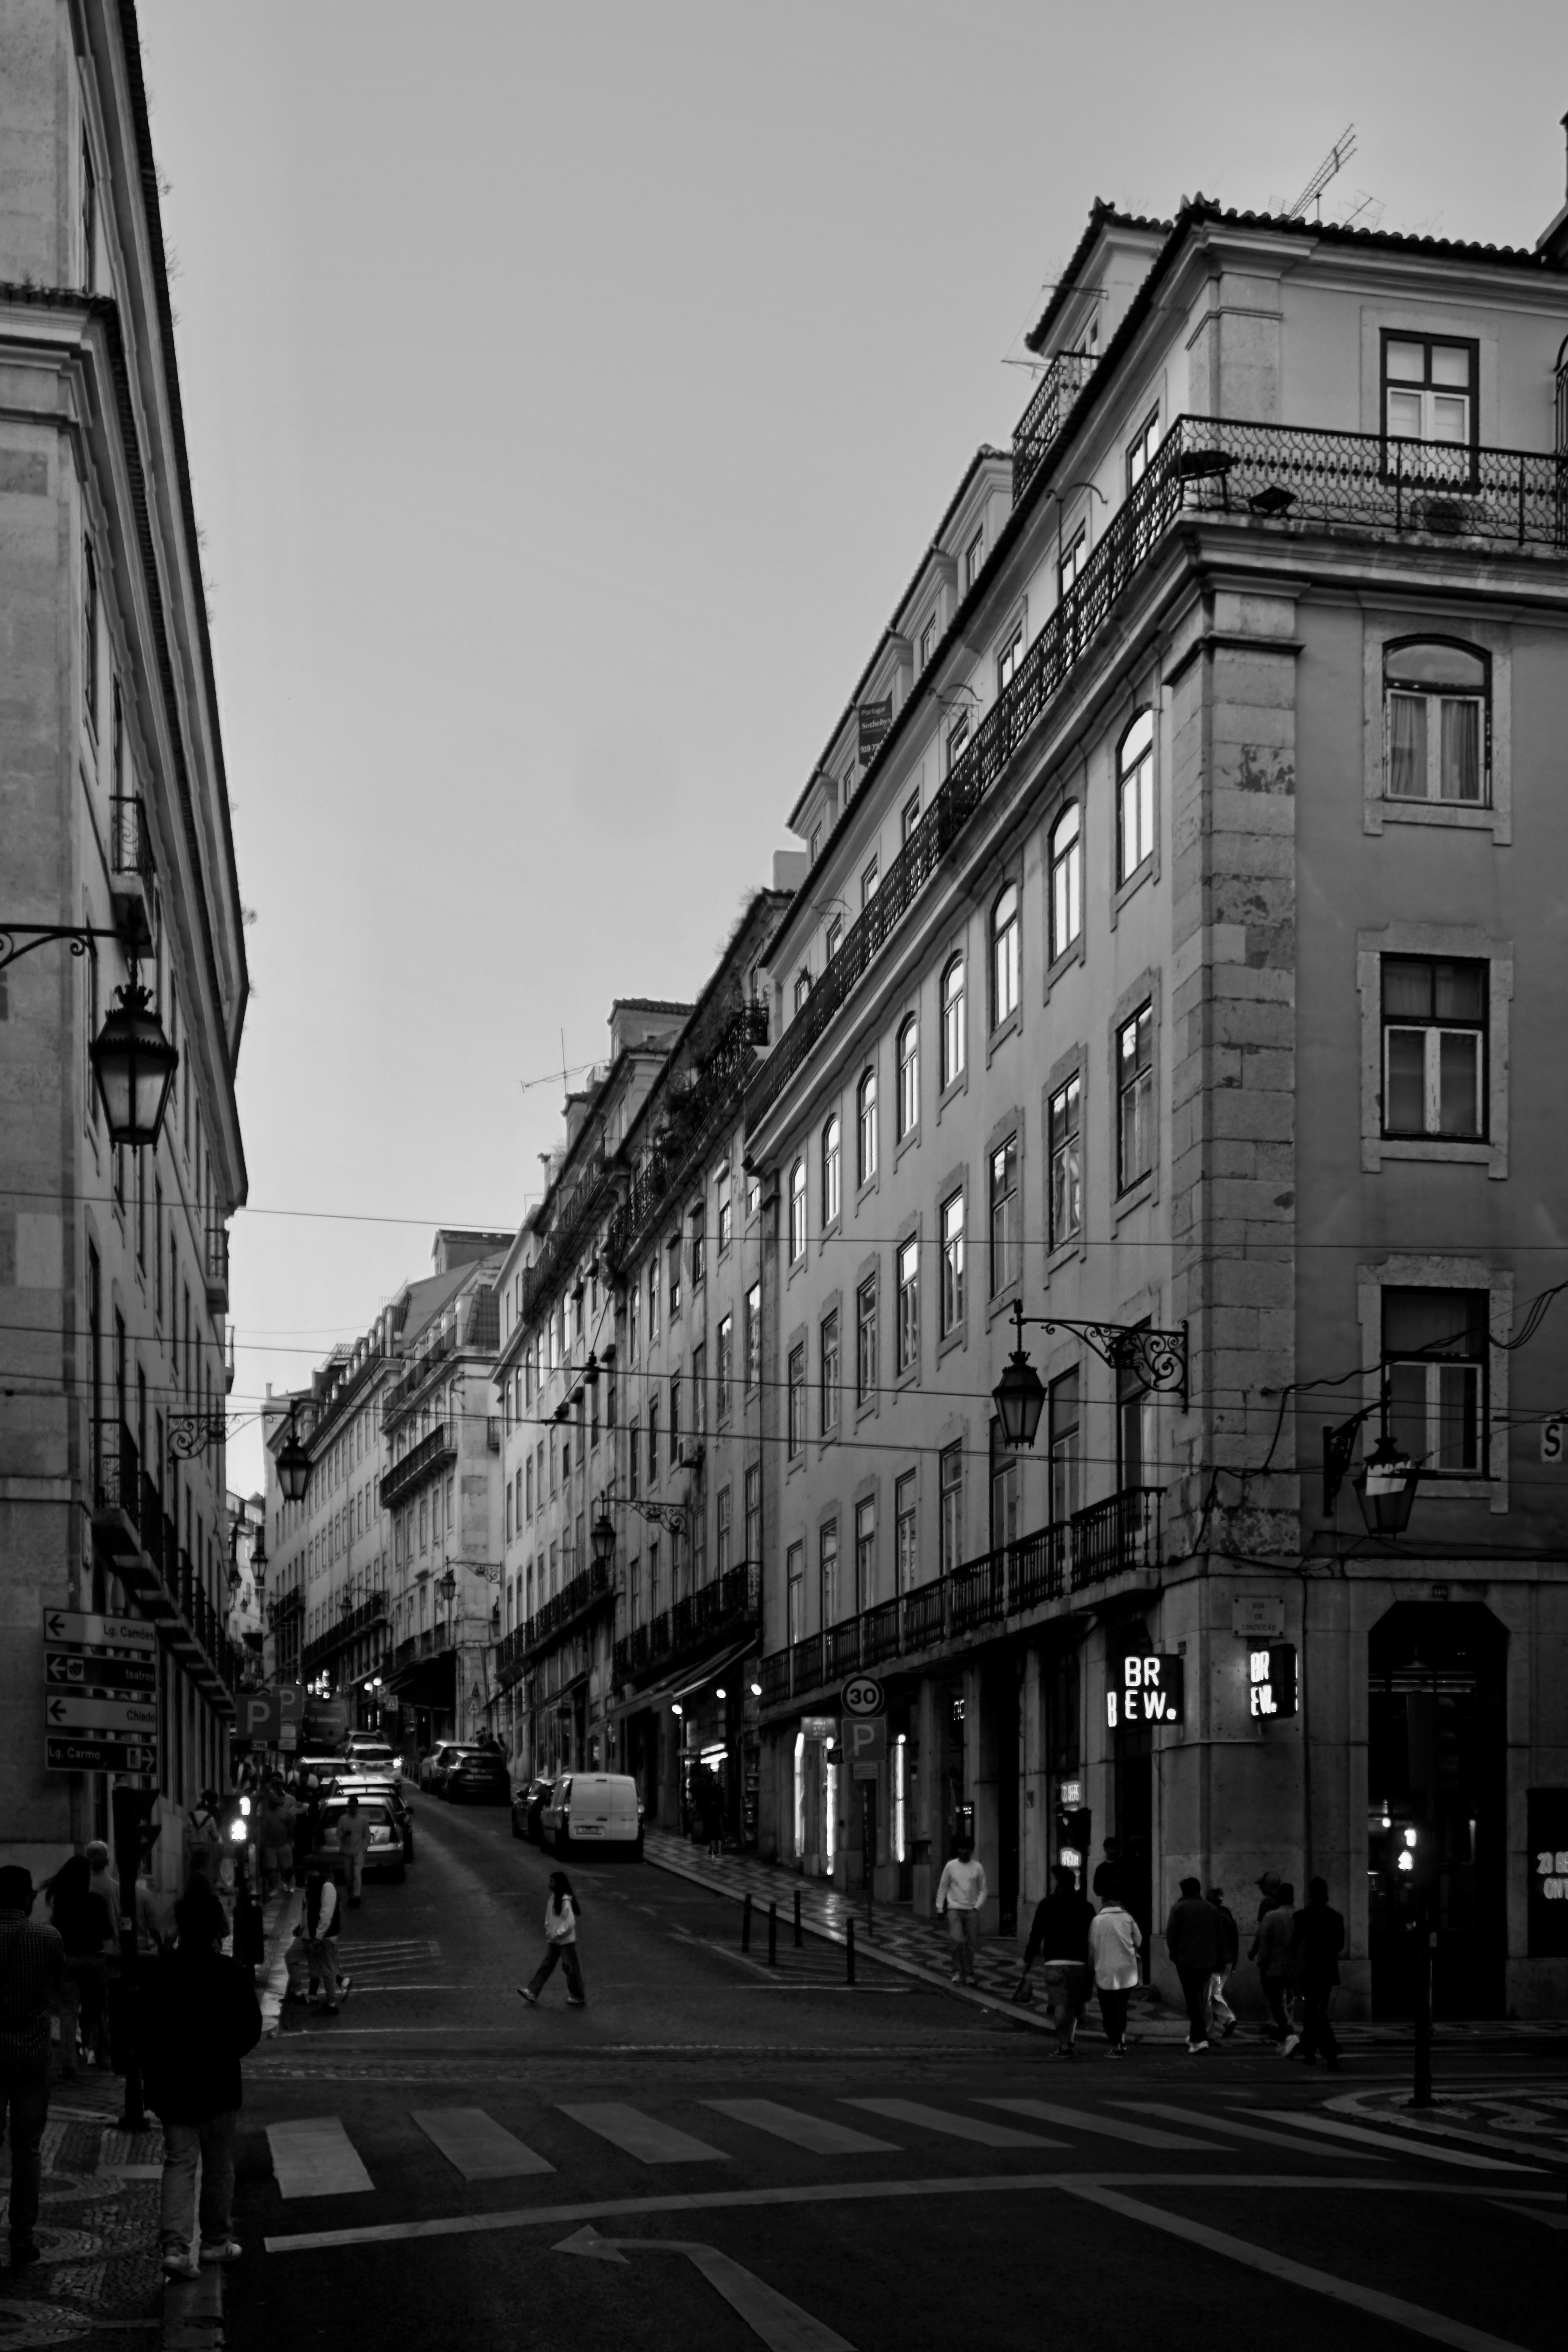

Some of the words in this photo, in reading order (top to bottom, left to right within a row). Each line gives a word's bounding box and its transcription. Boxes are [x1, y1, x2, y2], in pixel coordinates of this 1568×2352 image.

[861, 706, 885, 716] Portugal
[860, 744, 871, 753] 919
[1545, 1424, 1560, 1456] S
[103, 1624, 117, 1637] Lg.
[120, 1626, 154, 1640] Camões
[125, 1668, 155, 1682] teatros
[279, 1690, 295, 1713] P
[850, 1688, 876, 1705] 30
[126, 1710, 155, 1722] Chiado
[246, 1700, 270, 1734] P
[853, 1724, 875, 1757] P
[49, 1746, 64, 1760] Lg.
[67, 1746, 100, 1760] Carmo
